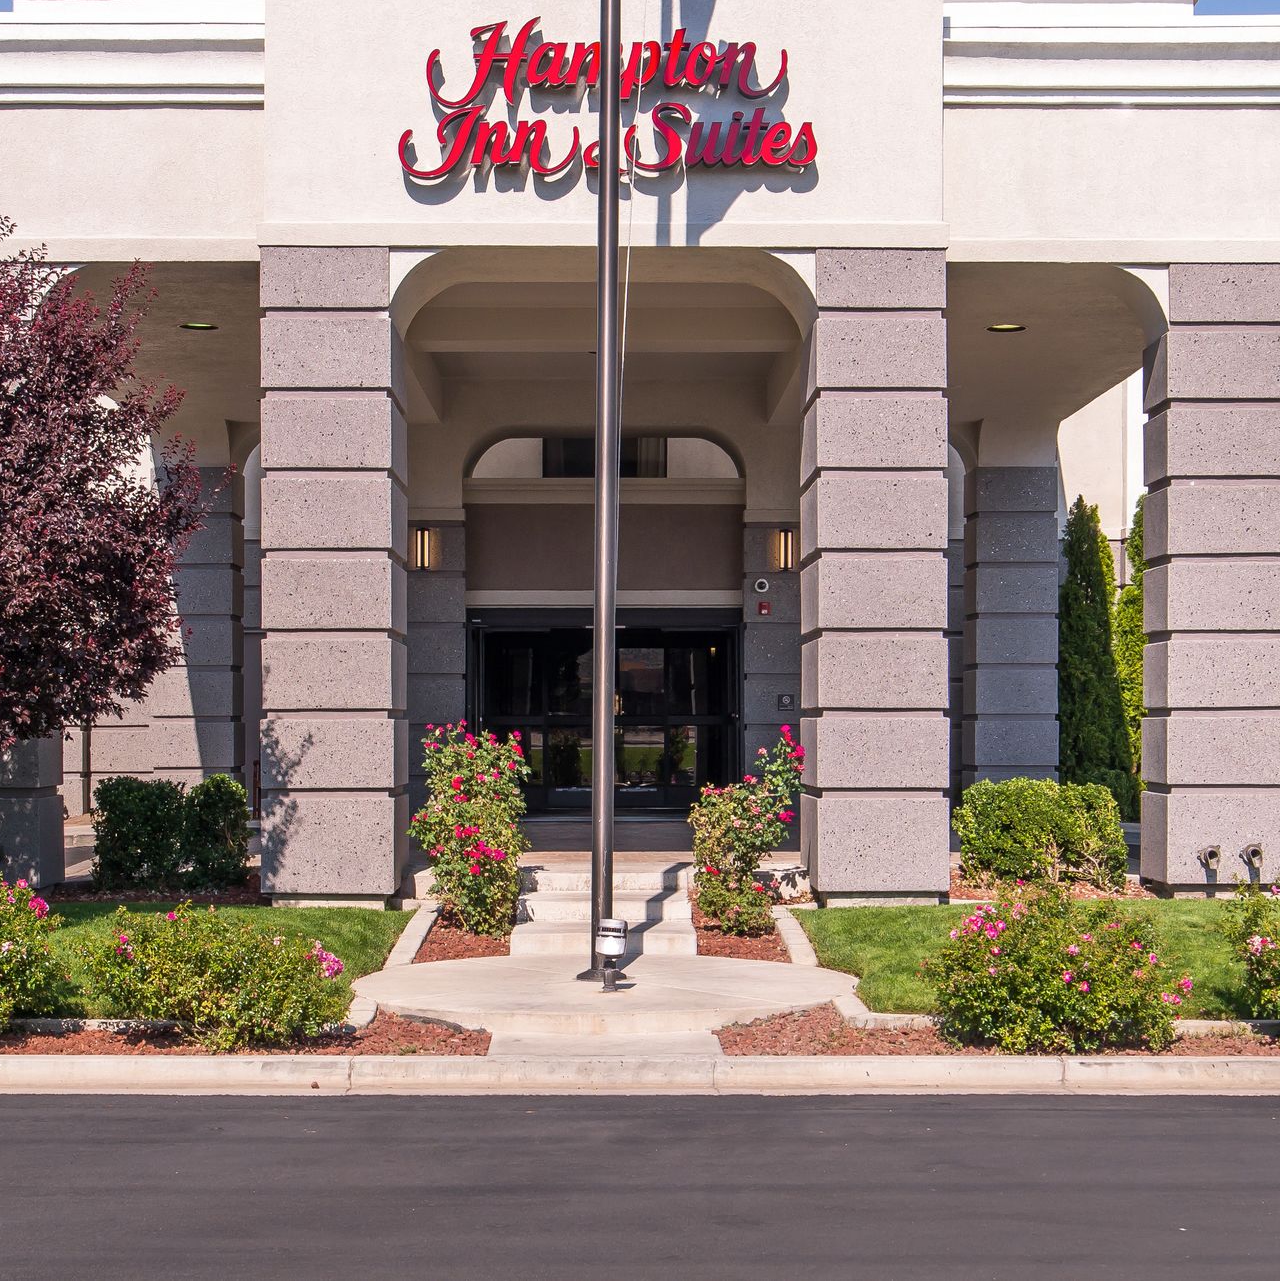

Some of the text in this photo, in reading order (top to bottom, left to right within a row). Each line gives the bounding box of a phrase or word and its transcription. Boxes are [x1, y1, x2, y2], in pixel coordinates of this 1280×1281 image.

[426, 16, 788, 108] Hampton
[398, 105, 580, 179] Inn
[624, 102, 818, 172] Suites
